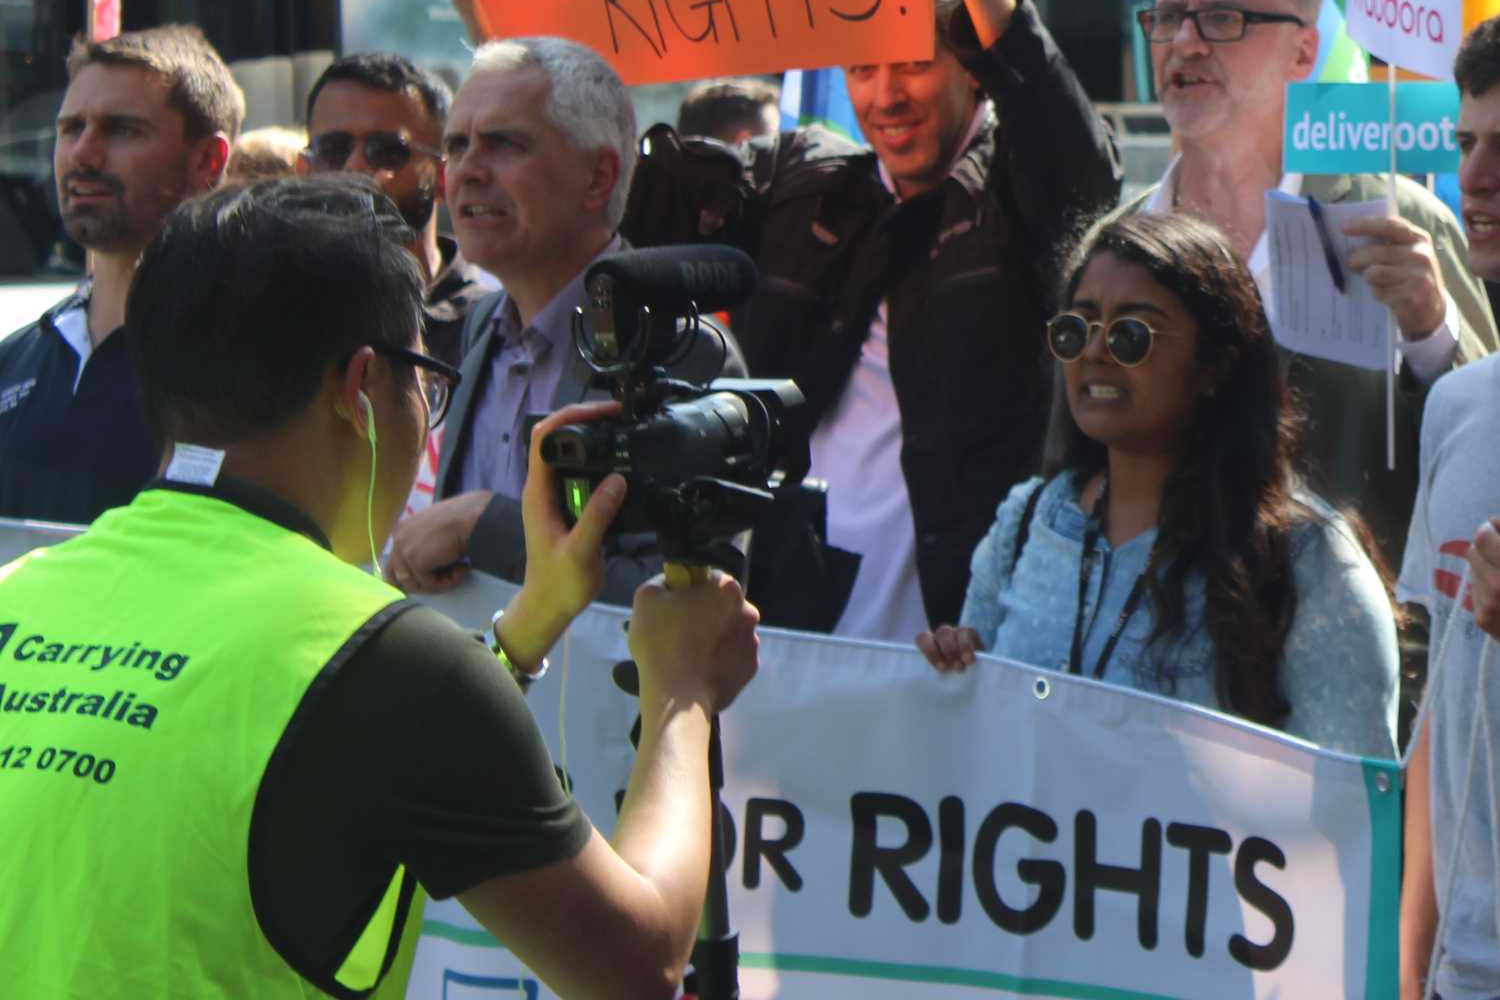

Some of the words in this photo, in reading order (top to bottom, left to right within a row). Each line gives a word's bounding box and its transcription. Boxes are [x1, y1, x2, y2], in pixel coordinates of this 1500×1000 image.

[1292, 111, 1457, 151] deliveroot
[13, 634, 191, 682] Carrying
[36, 747, 117, 784] 0700
[847, 790, 1295, 973] RIGHTS
